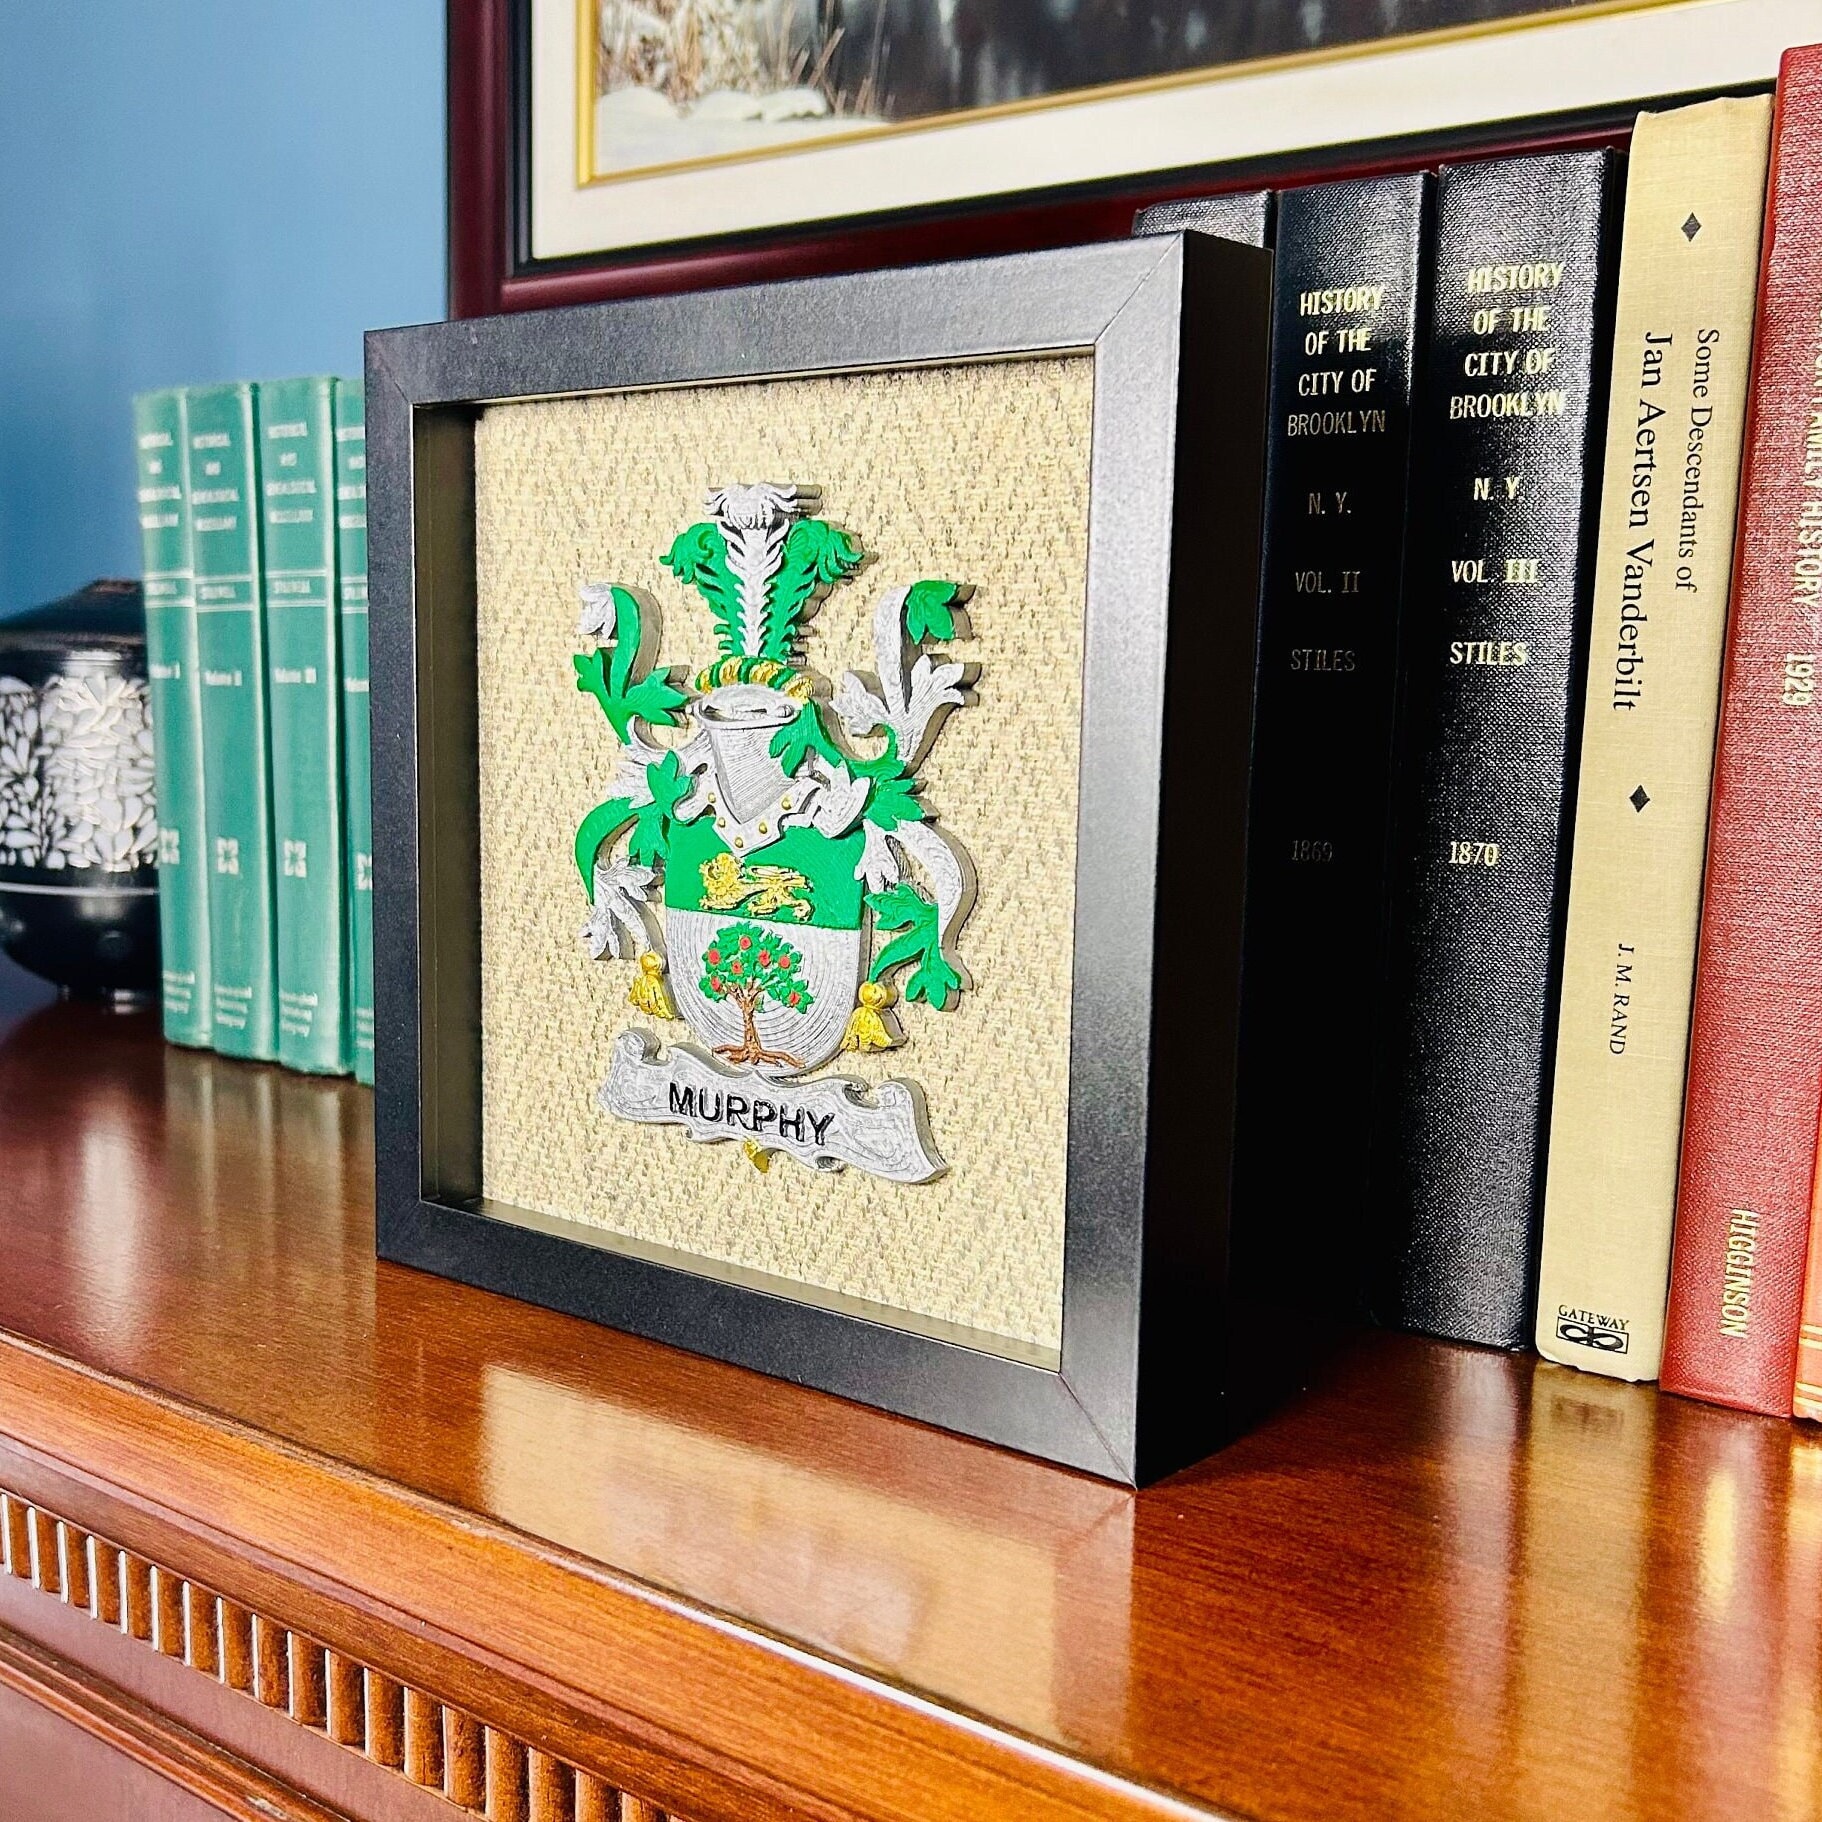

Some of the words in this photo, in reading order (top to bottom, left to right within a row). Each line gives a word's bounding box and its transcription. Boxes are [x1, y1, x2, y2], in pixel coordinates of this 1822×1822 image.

[1468, 263, 1565, 294] HISTORY
[1299, 285, 1385, 316] HISTORY
[1473, 308, 1499, 336] OF
[1512, 306, 1550, 333] THE
[1304, 331, 1329, 356] OF
[1336, 328, 1372, 353] THE
[1464, 351, 1516, 378] CITY
[1525, 349, 1554, 374] OF
[1641, 331, 1673, 389] Jan
[1692, 328, 1720, 398] Some
[1298, 371, 1344, 397] CITY
[1351, 368, 1377, 393] OF
[1449, 390, 1565, 420] BROOKLYN
[1287, 410, 1386, 437] BROOKLYN
[1629, 399, 1667, 529] Aertsen
[1678, 405, 1713, 559] Descendants
[1308, 492, 1326, 515] N.
[1335, 491, 1352, 514] Y.
[1791, 500, 1822, 609] HISTORY
[1295, 571, 1332, 594] VOL.
[1341, 570, 1361, 593] II
[1451, 560, 1495, 584] VOL.
[1505, 558, 1539, 583] III
[1675, 566, 1698, 594] of
[1612, 538, 1655, 711] Vanderbilt
[1291, 649, 1356, 671] STILES
[1449, 641, 1528, 666] STILES
[1782, 652, 1818, 706] 1929
[1291, 839, 1333, 863] 1869
[1448, 841, 1499, 866] 1870
[1618, 943, 1635, 957] J.
[1614, 963, 1633, 987] M.
[1609, 992, 1631, 1056] RAND
[669, 1082, 835, 1145] MURPHY
[1720, 1208, 1760, 1338] HIGGINSON
[1558, 1304, 1630, 1330] GATEWAY
